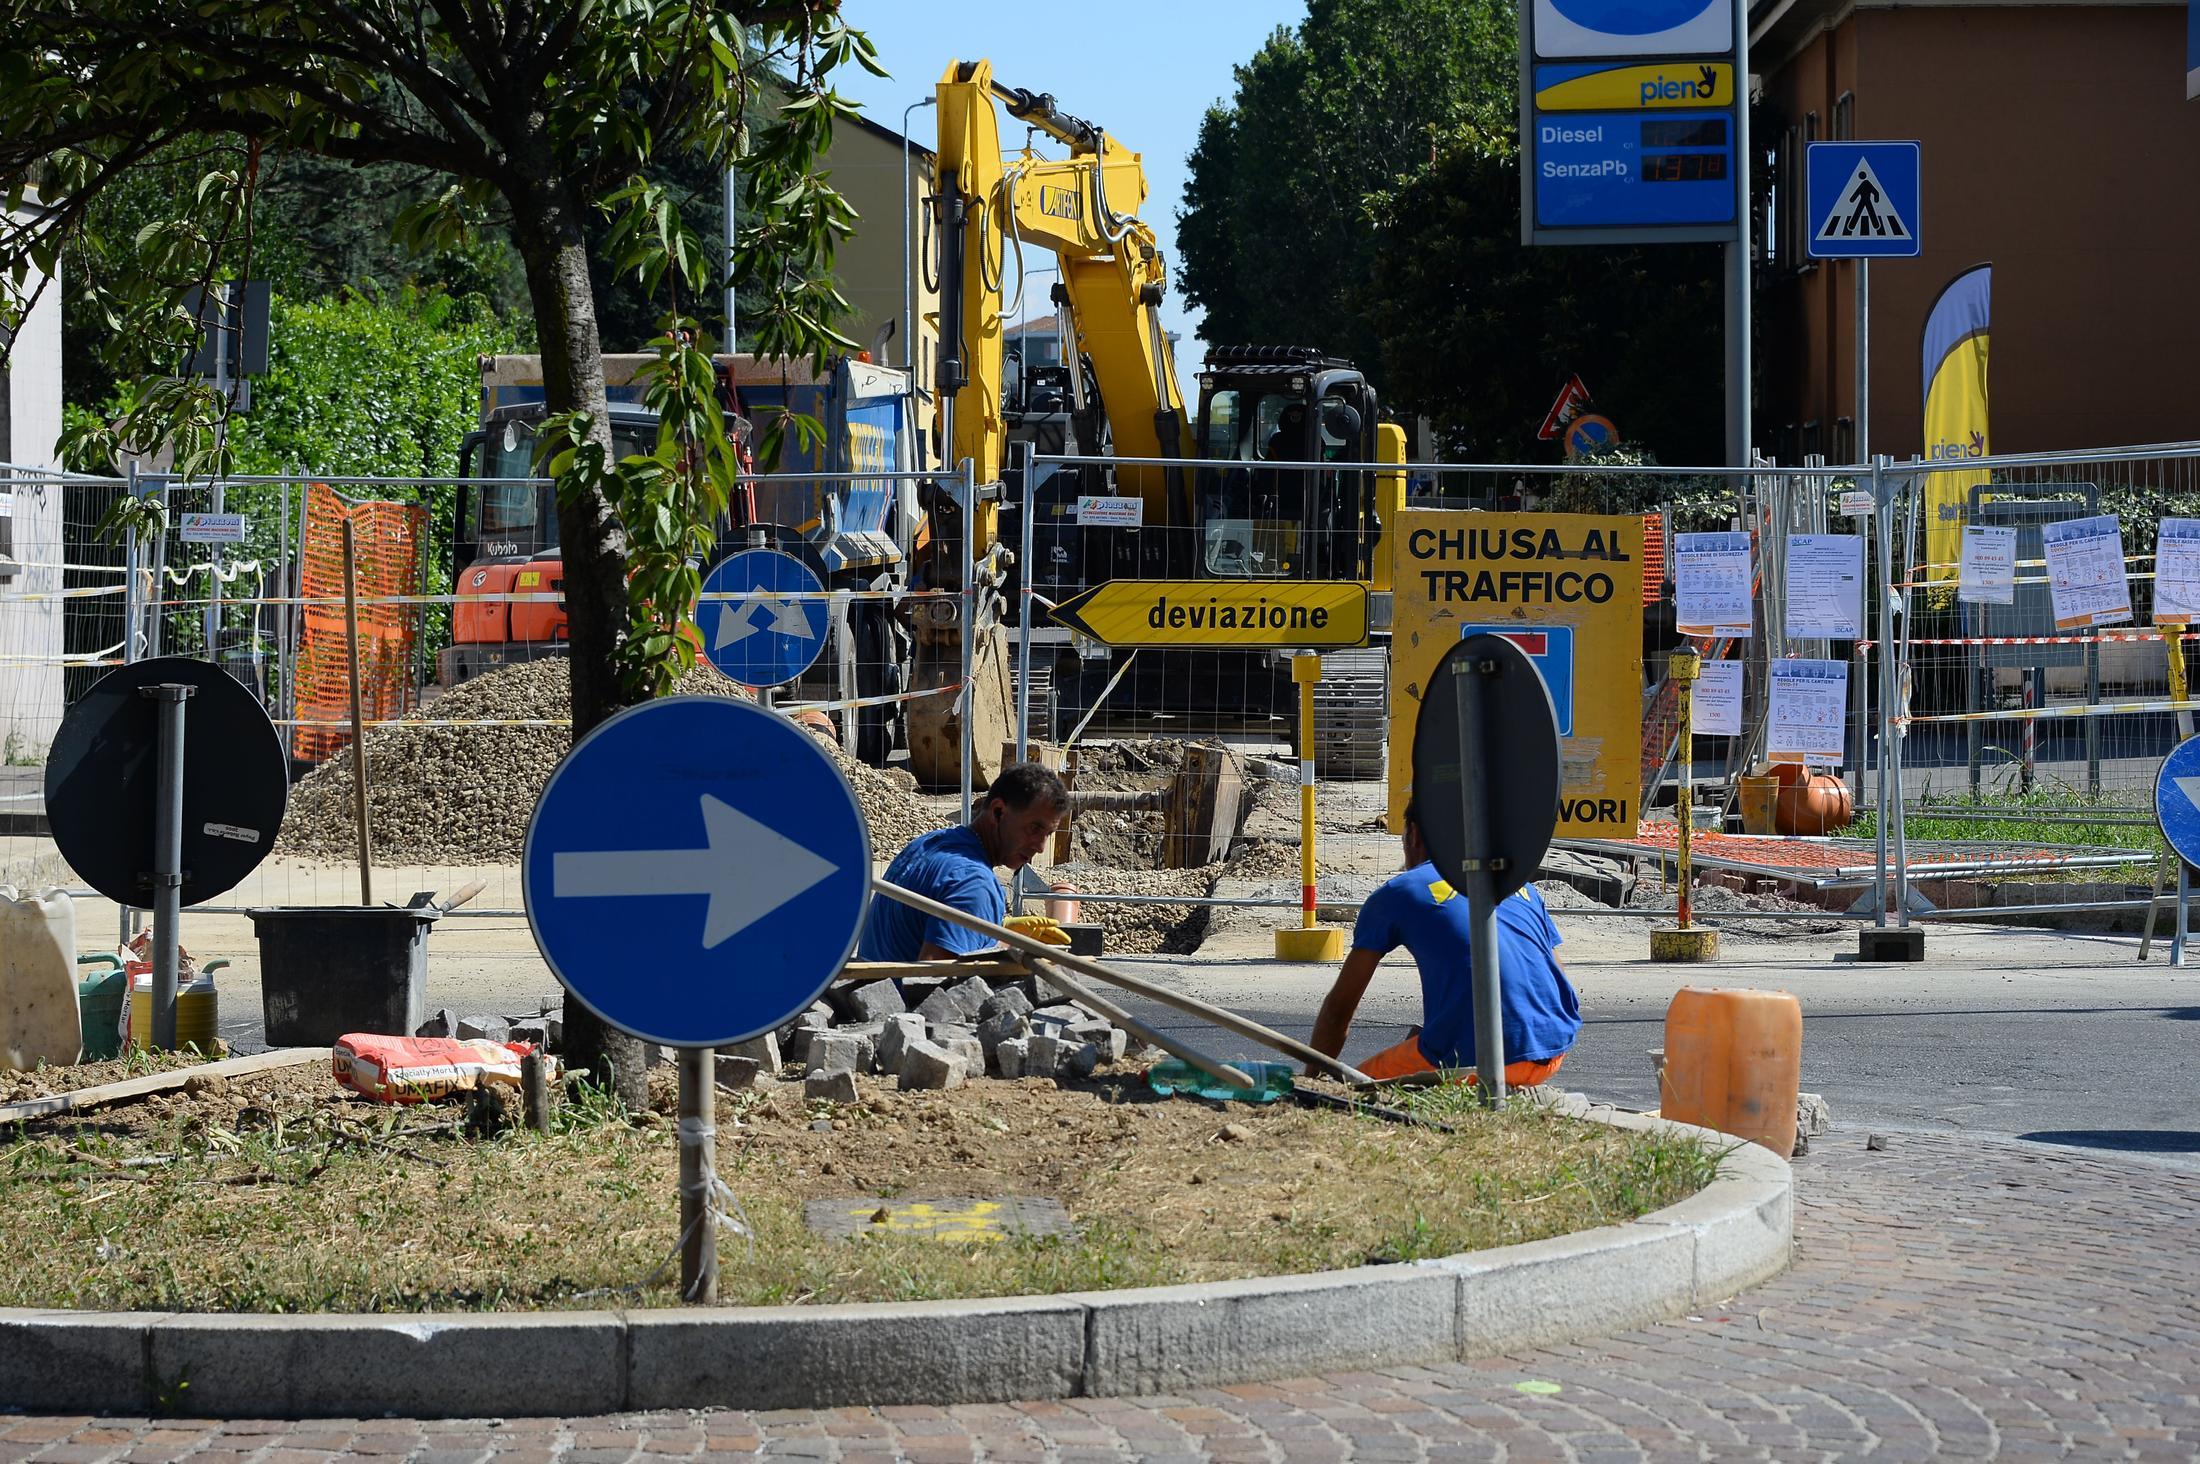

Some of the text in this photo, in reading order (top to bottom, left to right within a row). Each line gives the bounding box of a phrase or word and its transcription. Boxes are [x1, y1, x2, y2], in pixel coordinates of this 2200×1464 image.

[1541, 126, 1603, 143] Diesel
[1543, 160, 1628, 178] SenzaPb
[487, 540, 518, 556] Kubota
[1408, 528, 1630, 562] CHIUSA AL
[1421, 570, 1615, 604] TRAFFICO
[1148, 596, 1329, 629] deviazione
[1556, 799, 1627, 824] VORI
